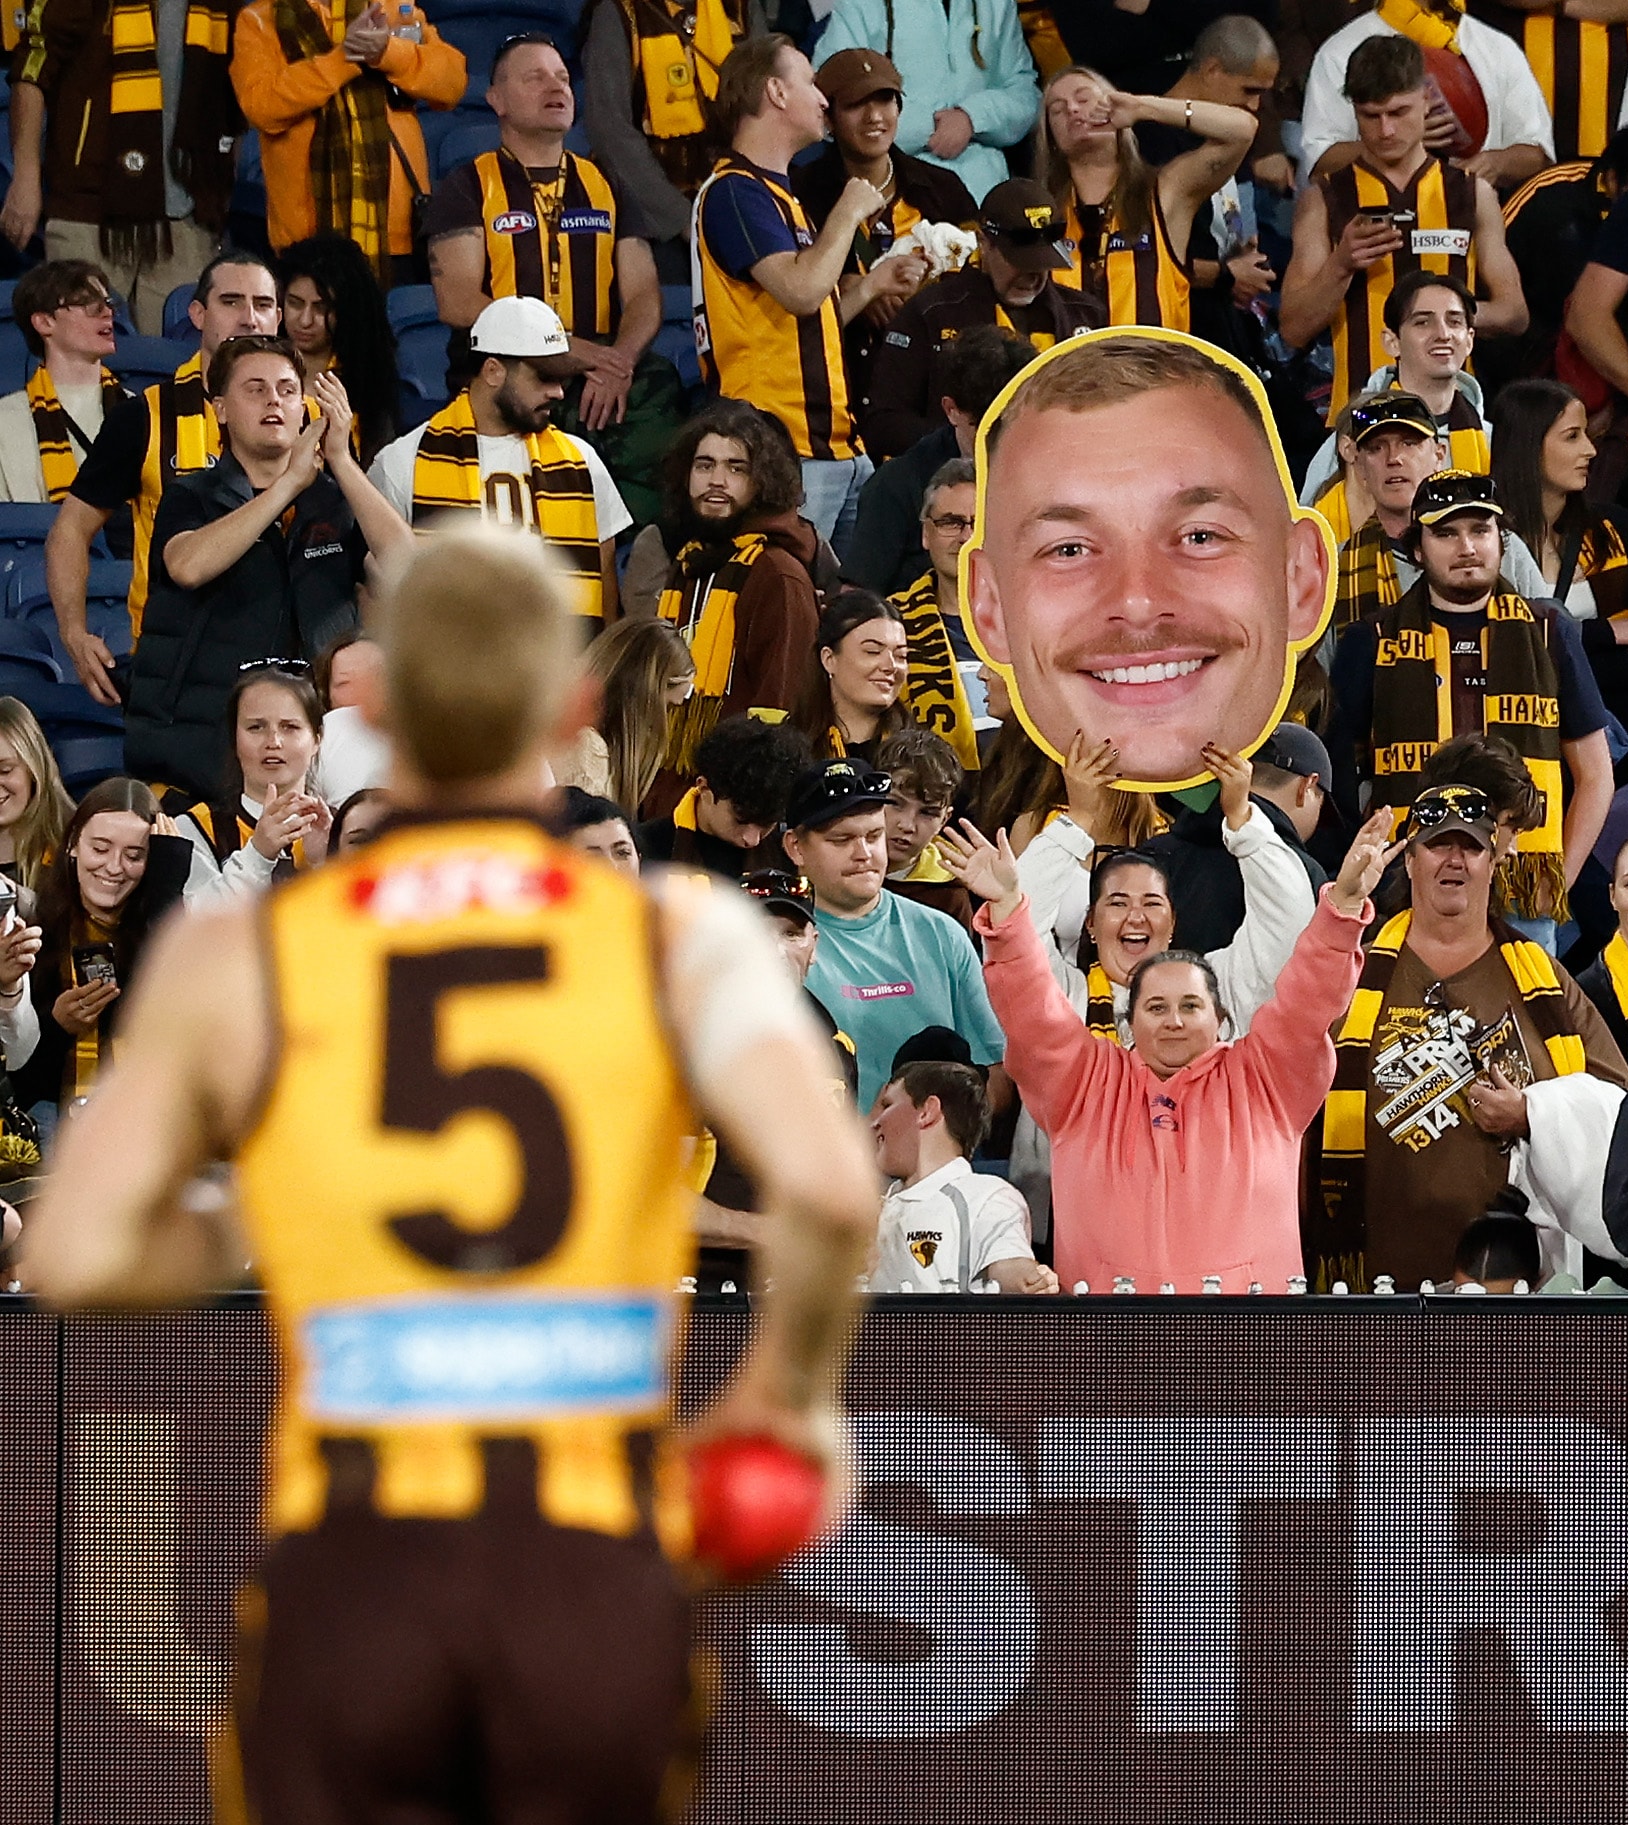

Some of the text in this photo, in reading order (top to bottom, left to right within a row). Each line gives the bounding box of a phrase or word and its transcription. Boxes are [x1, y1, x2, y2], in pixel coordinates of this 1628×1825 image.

[496, 214, 533, 231] AFL
[560, 213, 611, 229] asmania
[1413, 236, 1451, 248] HSBC
[891, 585, 957, 734] HAWKS
[1464, 677, 1487, 686] TAS
[1386, 1068, 1449, 1120] HAWTHORN
[383, 942, 576, 1270] 5
[1404, 1102, 1461, 1154] 13 14
[906, 1230, 943, 1241] HAWKS
